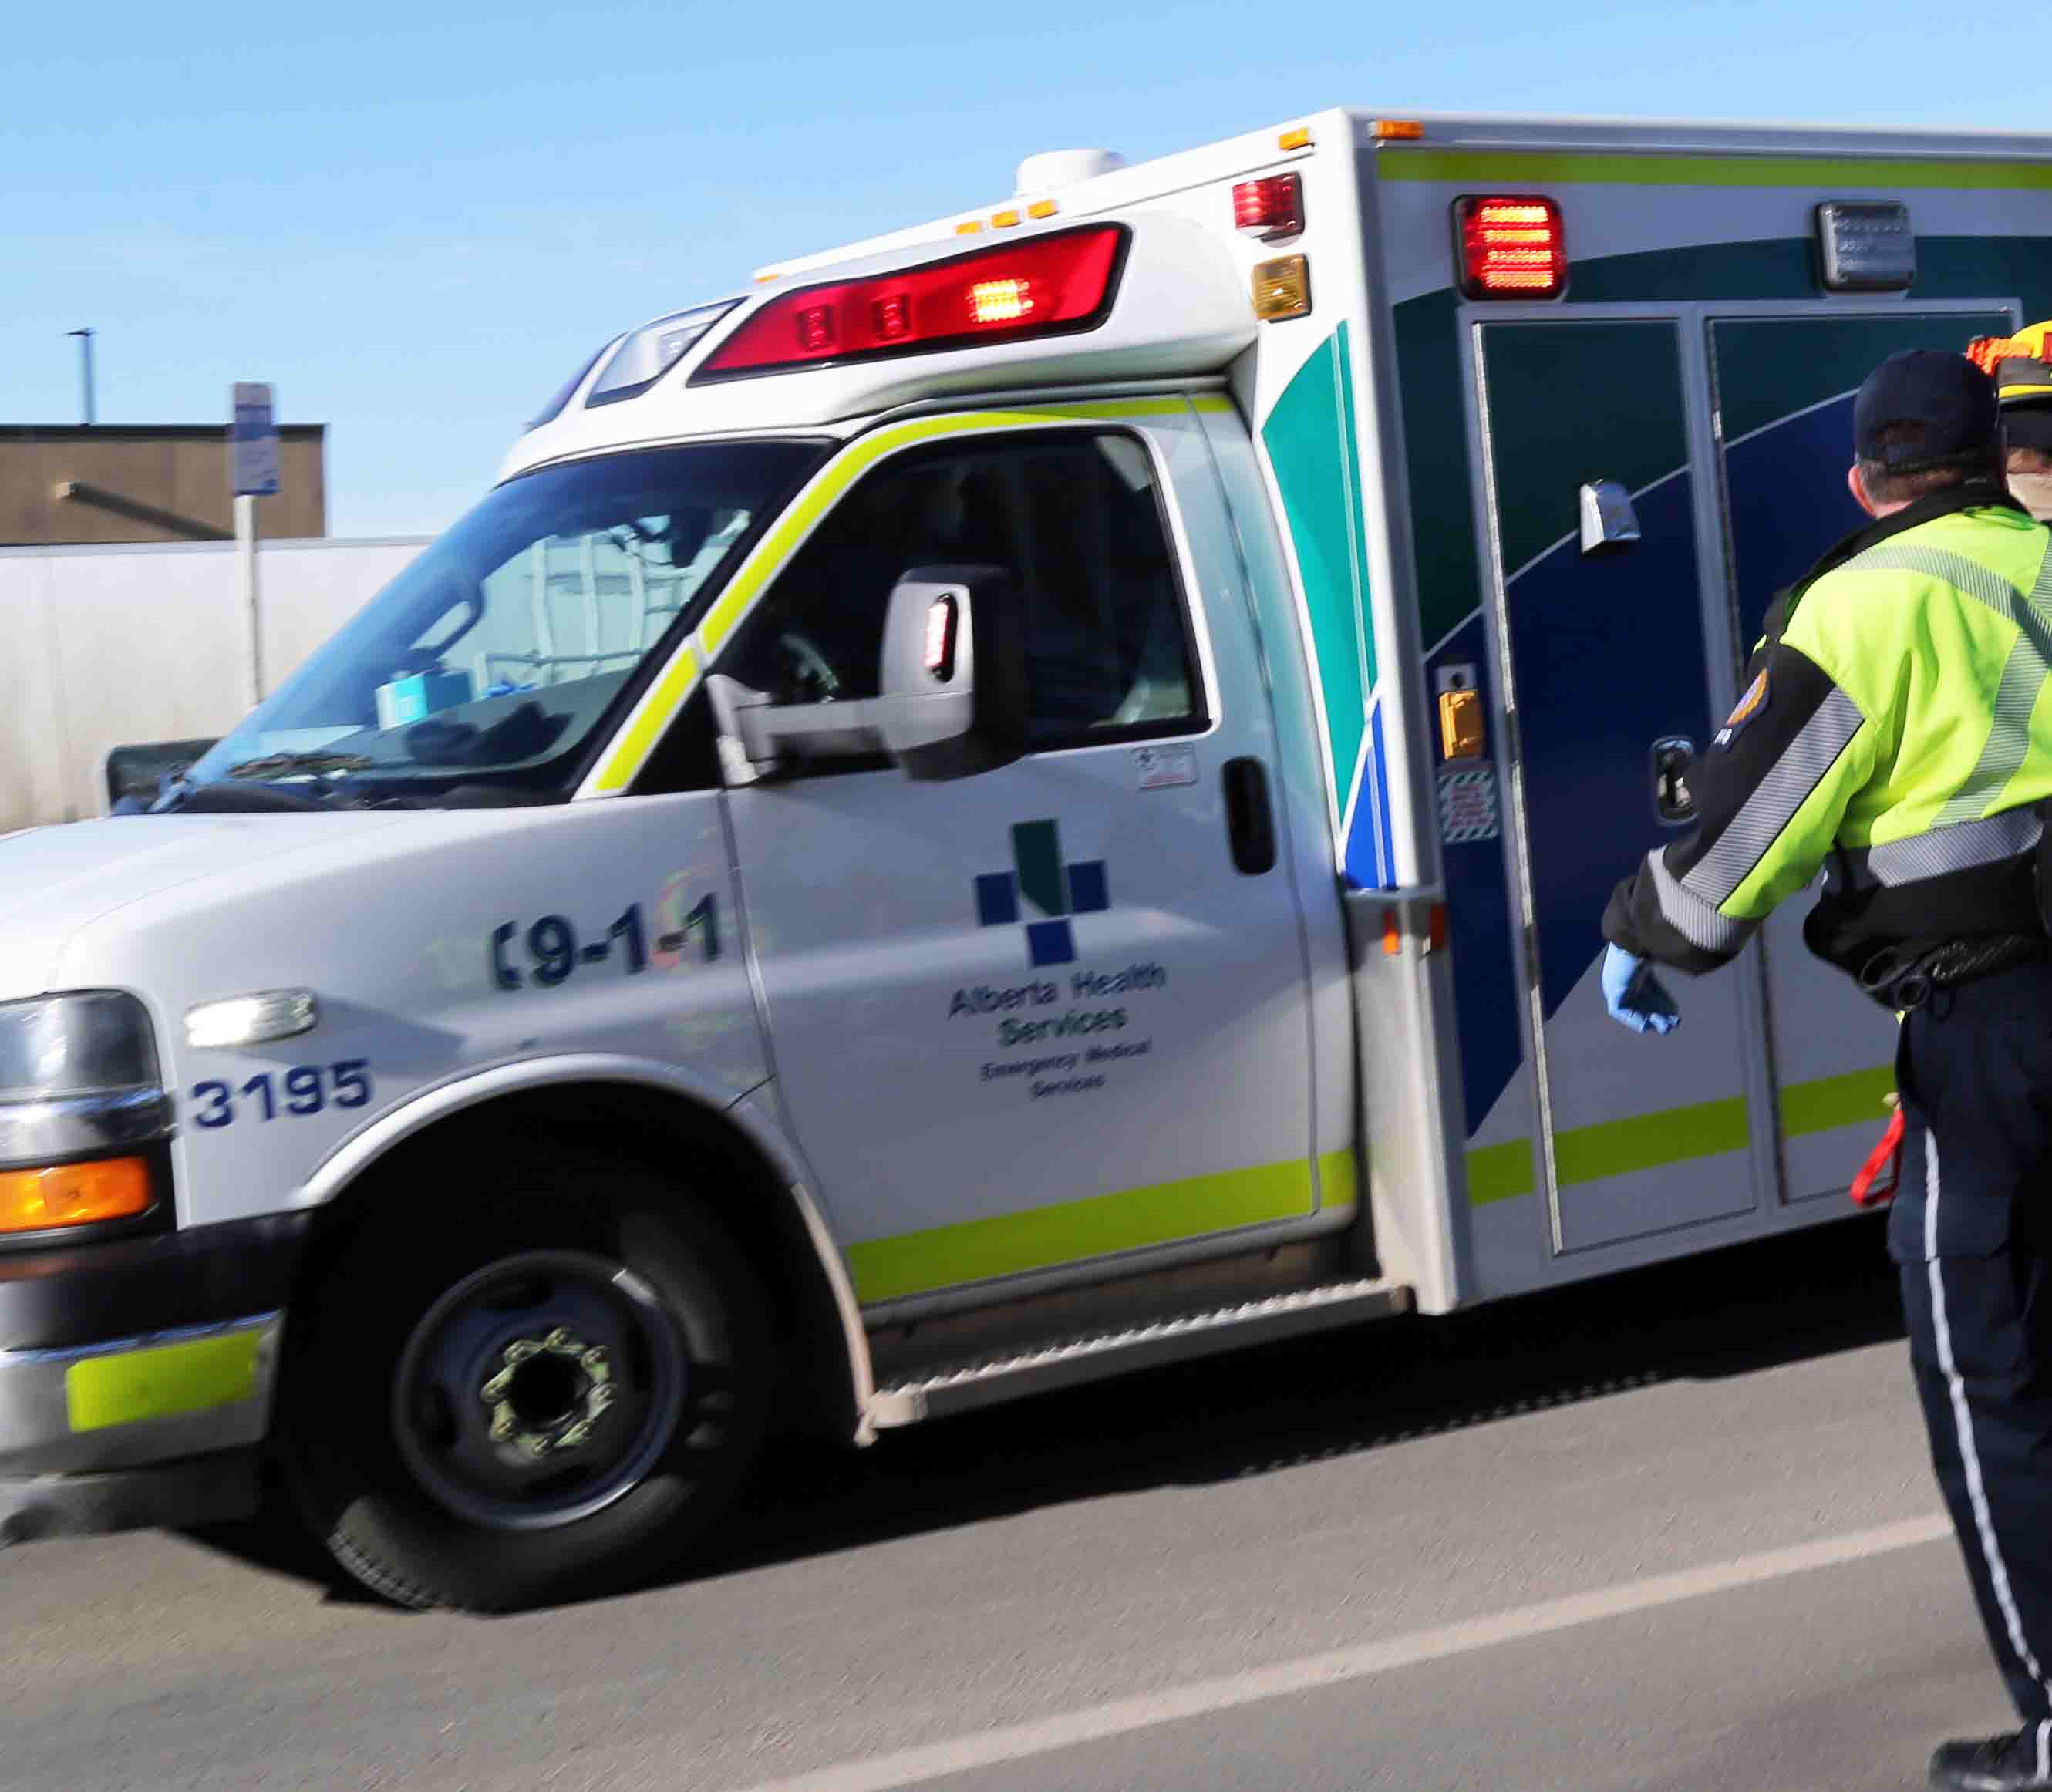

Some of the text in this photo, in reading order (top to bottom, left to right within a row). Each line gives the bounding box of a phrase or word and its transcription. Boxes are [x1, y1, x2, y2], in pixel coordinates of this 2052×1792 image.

[527, 891, 721, 986] 9-1-1
[948, 962, 1166, 1019] Alberta Health
[999, 1007, 1127, 1046] Services
[981, 1039, 1151, 1080] Emergency Medical
[193, 1058, 374, 1130] 3195
[1031, 1075, 1106, 1098] Services
